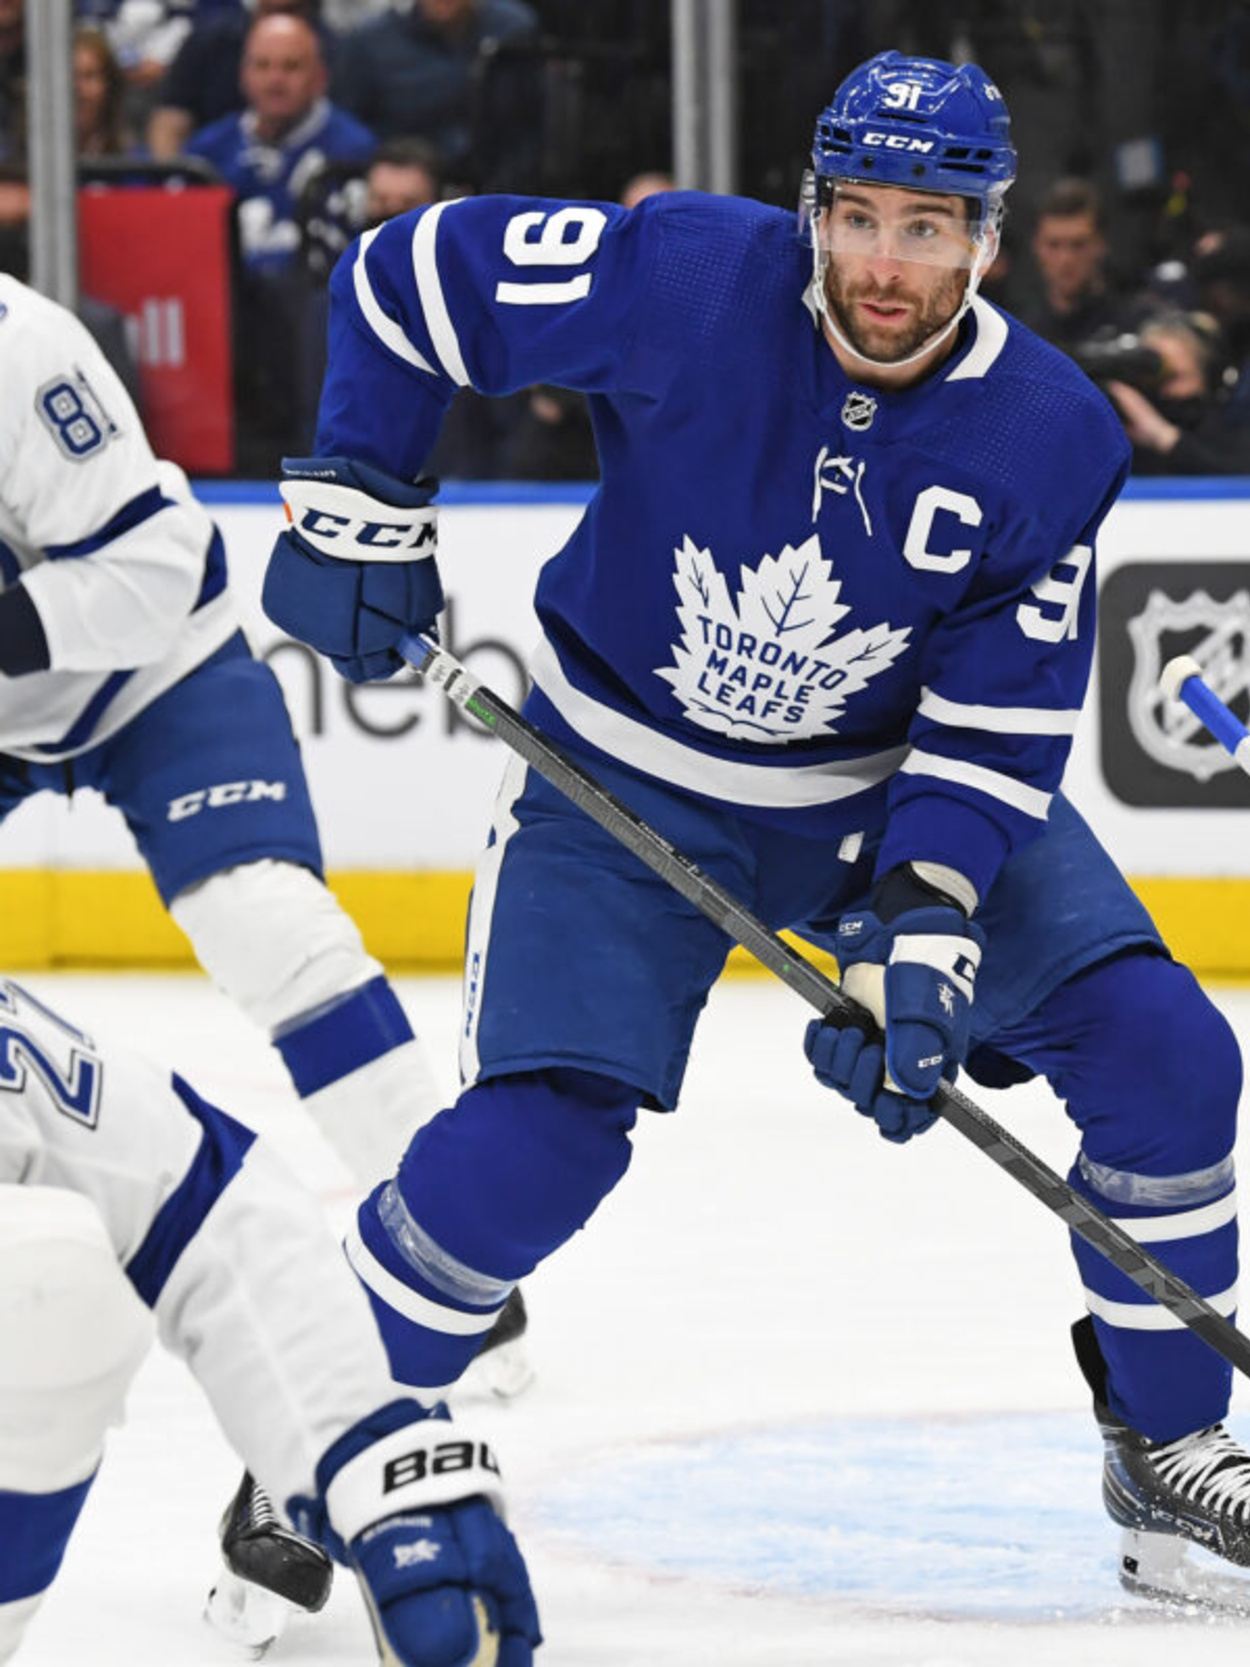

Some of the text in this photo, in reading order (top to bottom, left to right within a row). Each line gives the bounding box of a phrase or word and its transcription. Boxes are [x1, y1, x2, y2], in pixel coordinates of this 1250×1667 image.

[880, 83, 923, 111] 91
[861, 132, 935, 154] CCM
[496, 207, 607, 304] 91
[300, 507, 440, 550] CCM
[903, 485, 983, 574] C
[1016, 544, 1092, 644] 9
[696, 614, 848, 690] TORONTO
[706, 649, 815, 704] MAPLE
[697, 671, 805, 723] LEAFS
[167, 780, 286, 822] CCM
